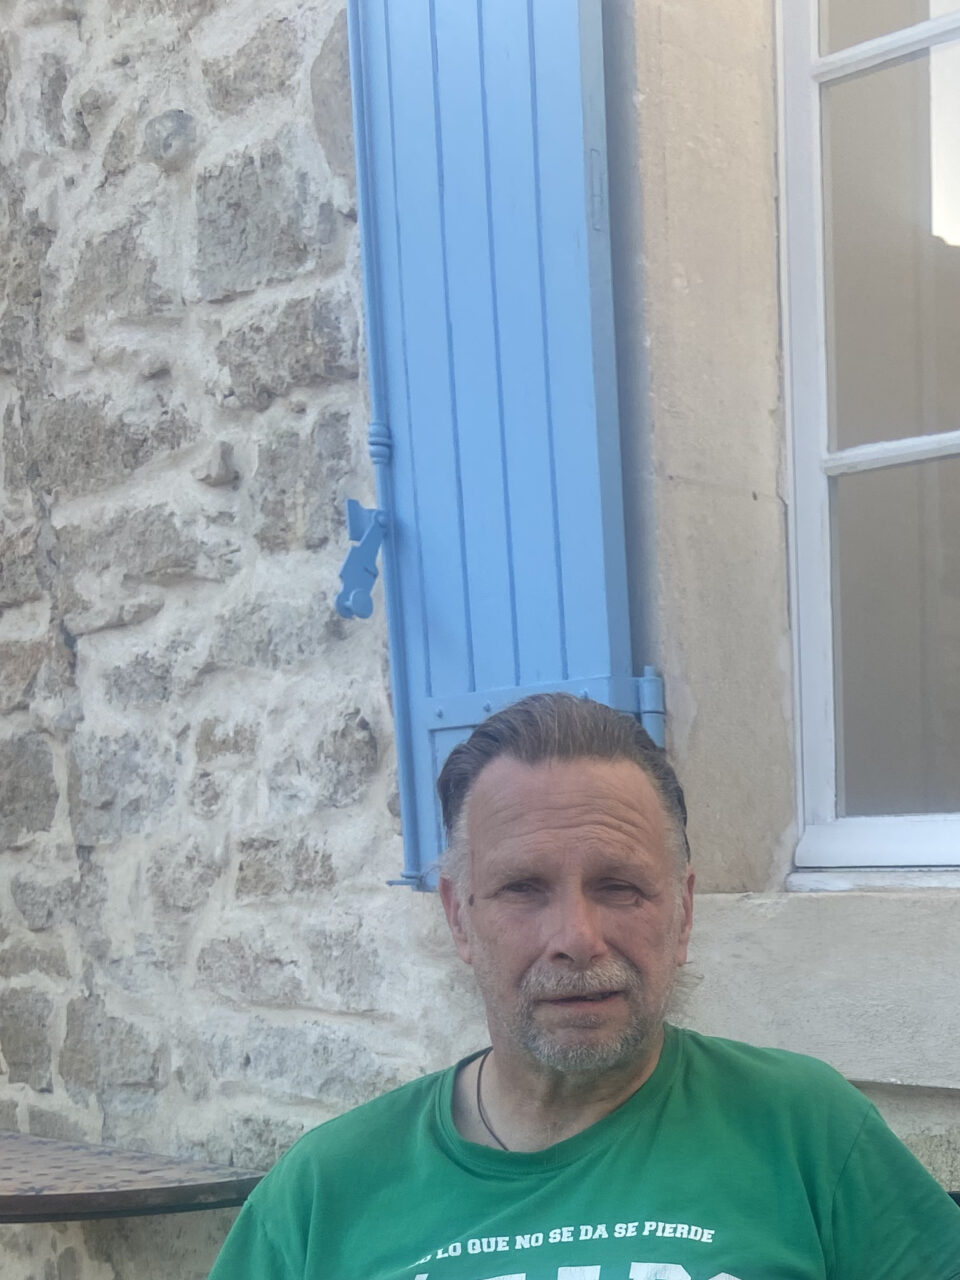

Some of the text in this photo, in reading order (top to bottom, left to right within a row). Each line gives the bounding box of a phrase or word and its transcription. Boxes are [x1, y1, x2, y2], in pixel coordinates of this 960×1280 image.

[436, 1221, 715, 1259] LO QUE NO SE DA SE PIERDE
